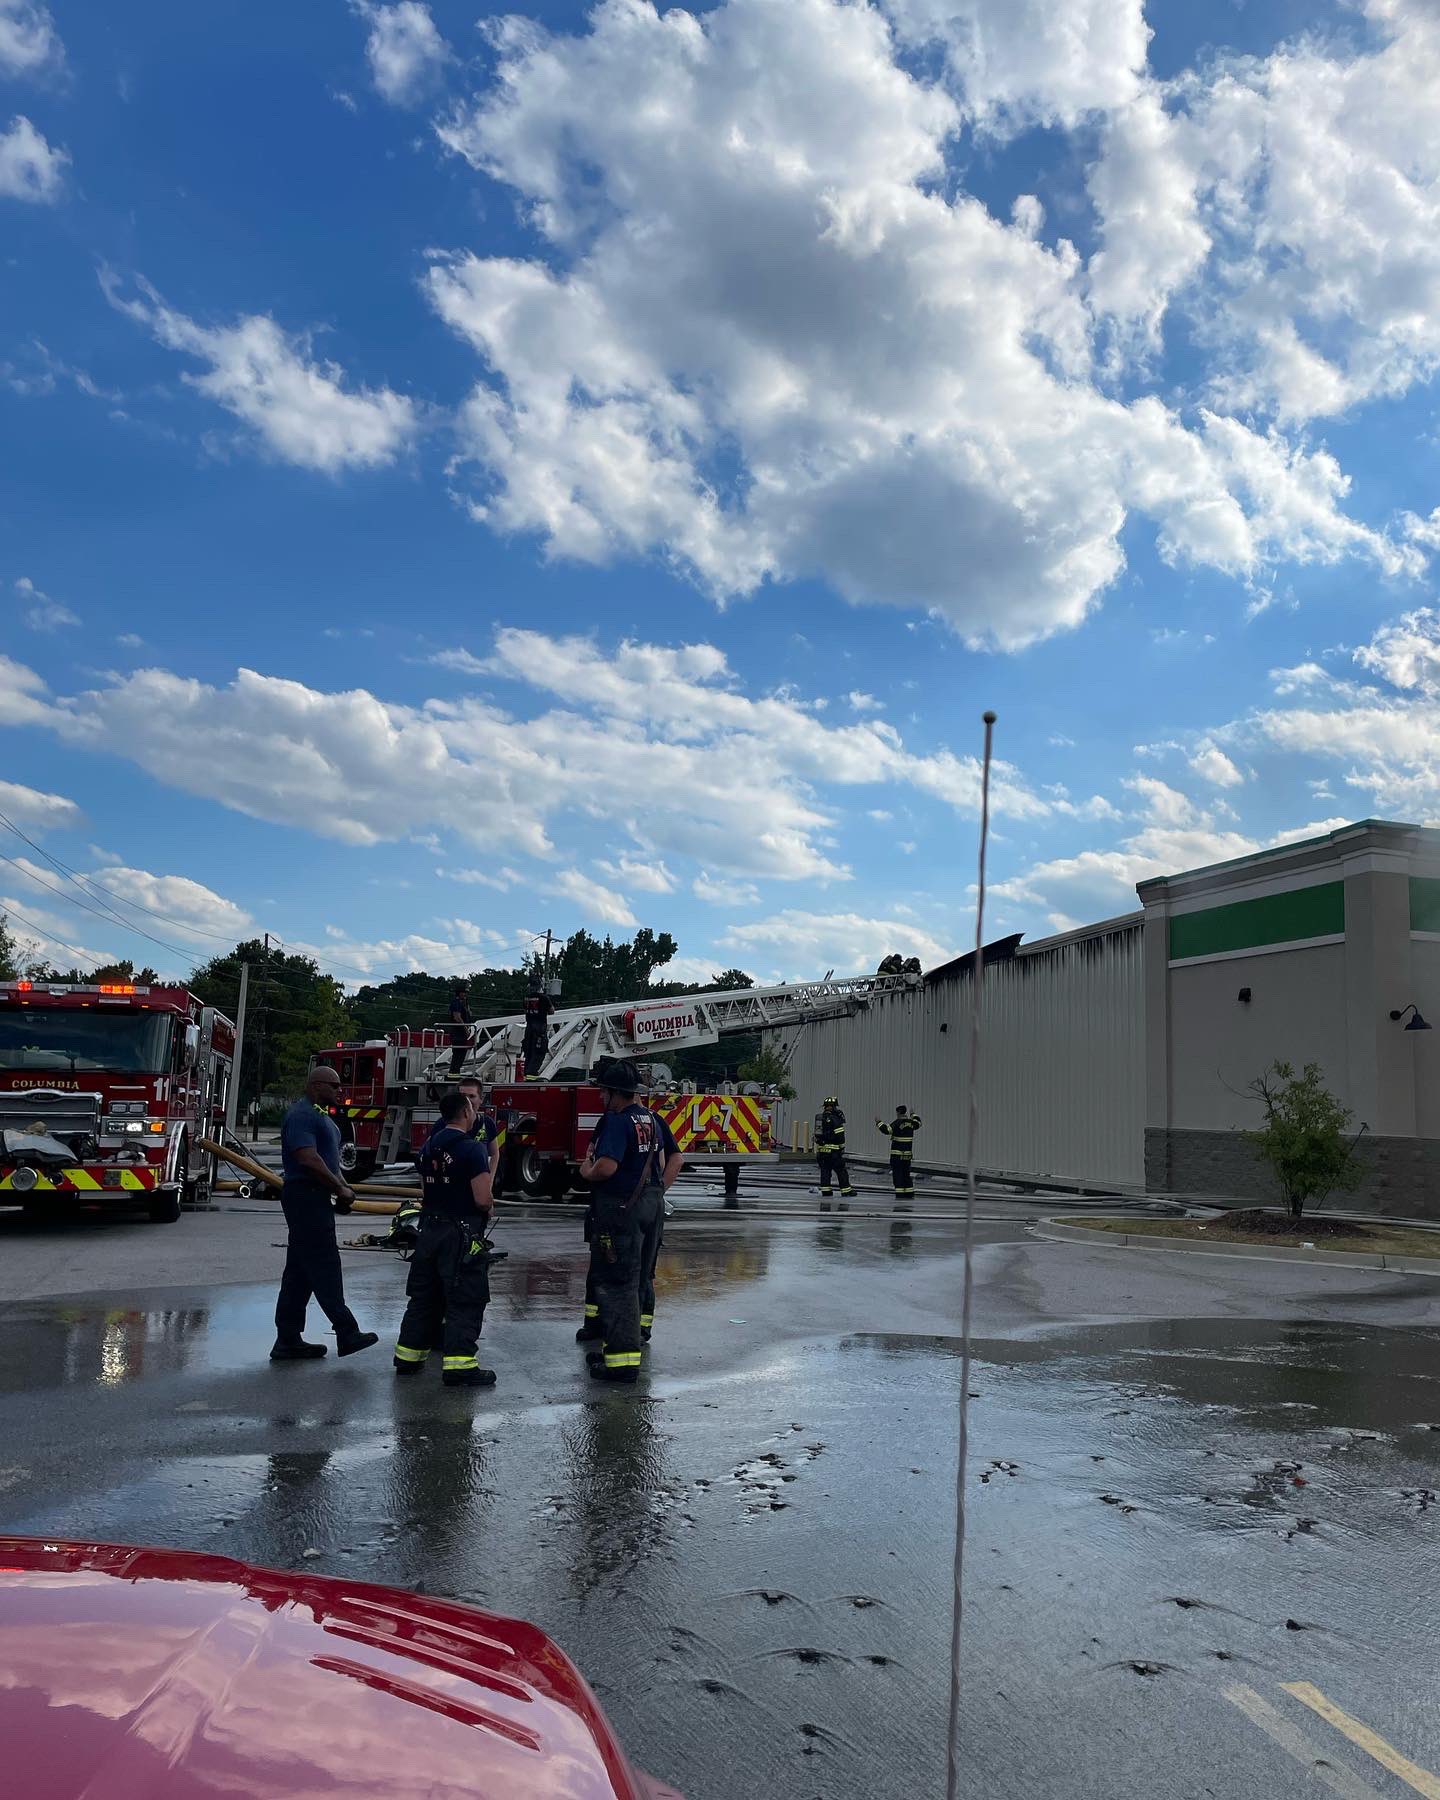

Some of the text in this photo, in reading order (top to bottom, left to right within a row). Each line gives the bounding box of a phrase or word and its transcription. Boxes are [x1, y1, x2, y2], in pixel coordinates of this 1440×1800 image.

[637, 1014, 695, 1034] COLUMBIA
[653, 1029, 675, 1039] TRUCK
[11, 1079, 80, 1090] COLUMBIA
[153, 1077, 170, 1102] 11
[692, 1104, 733, 1132] L 7
